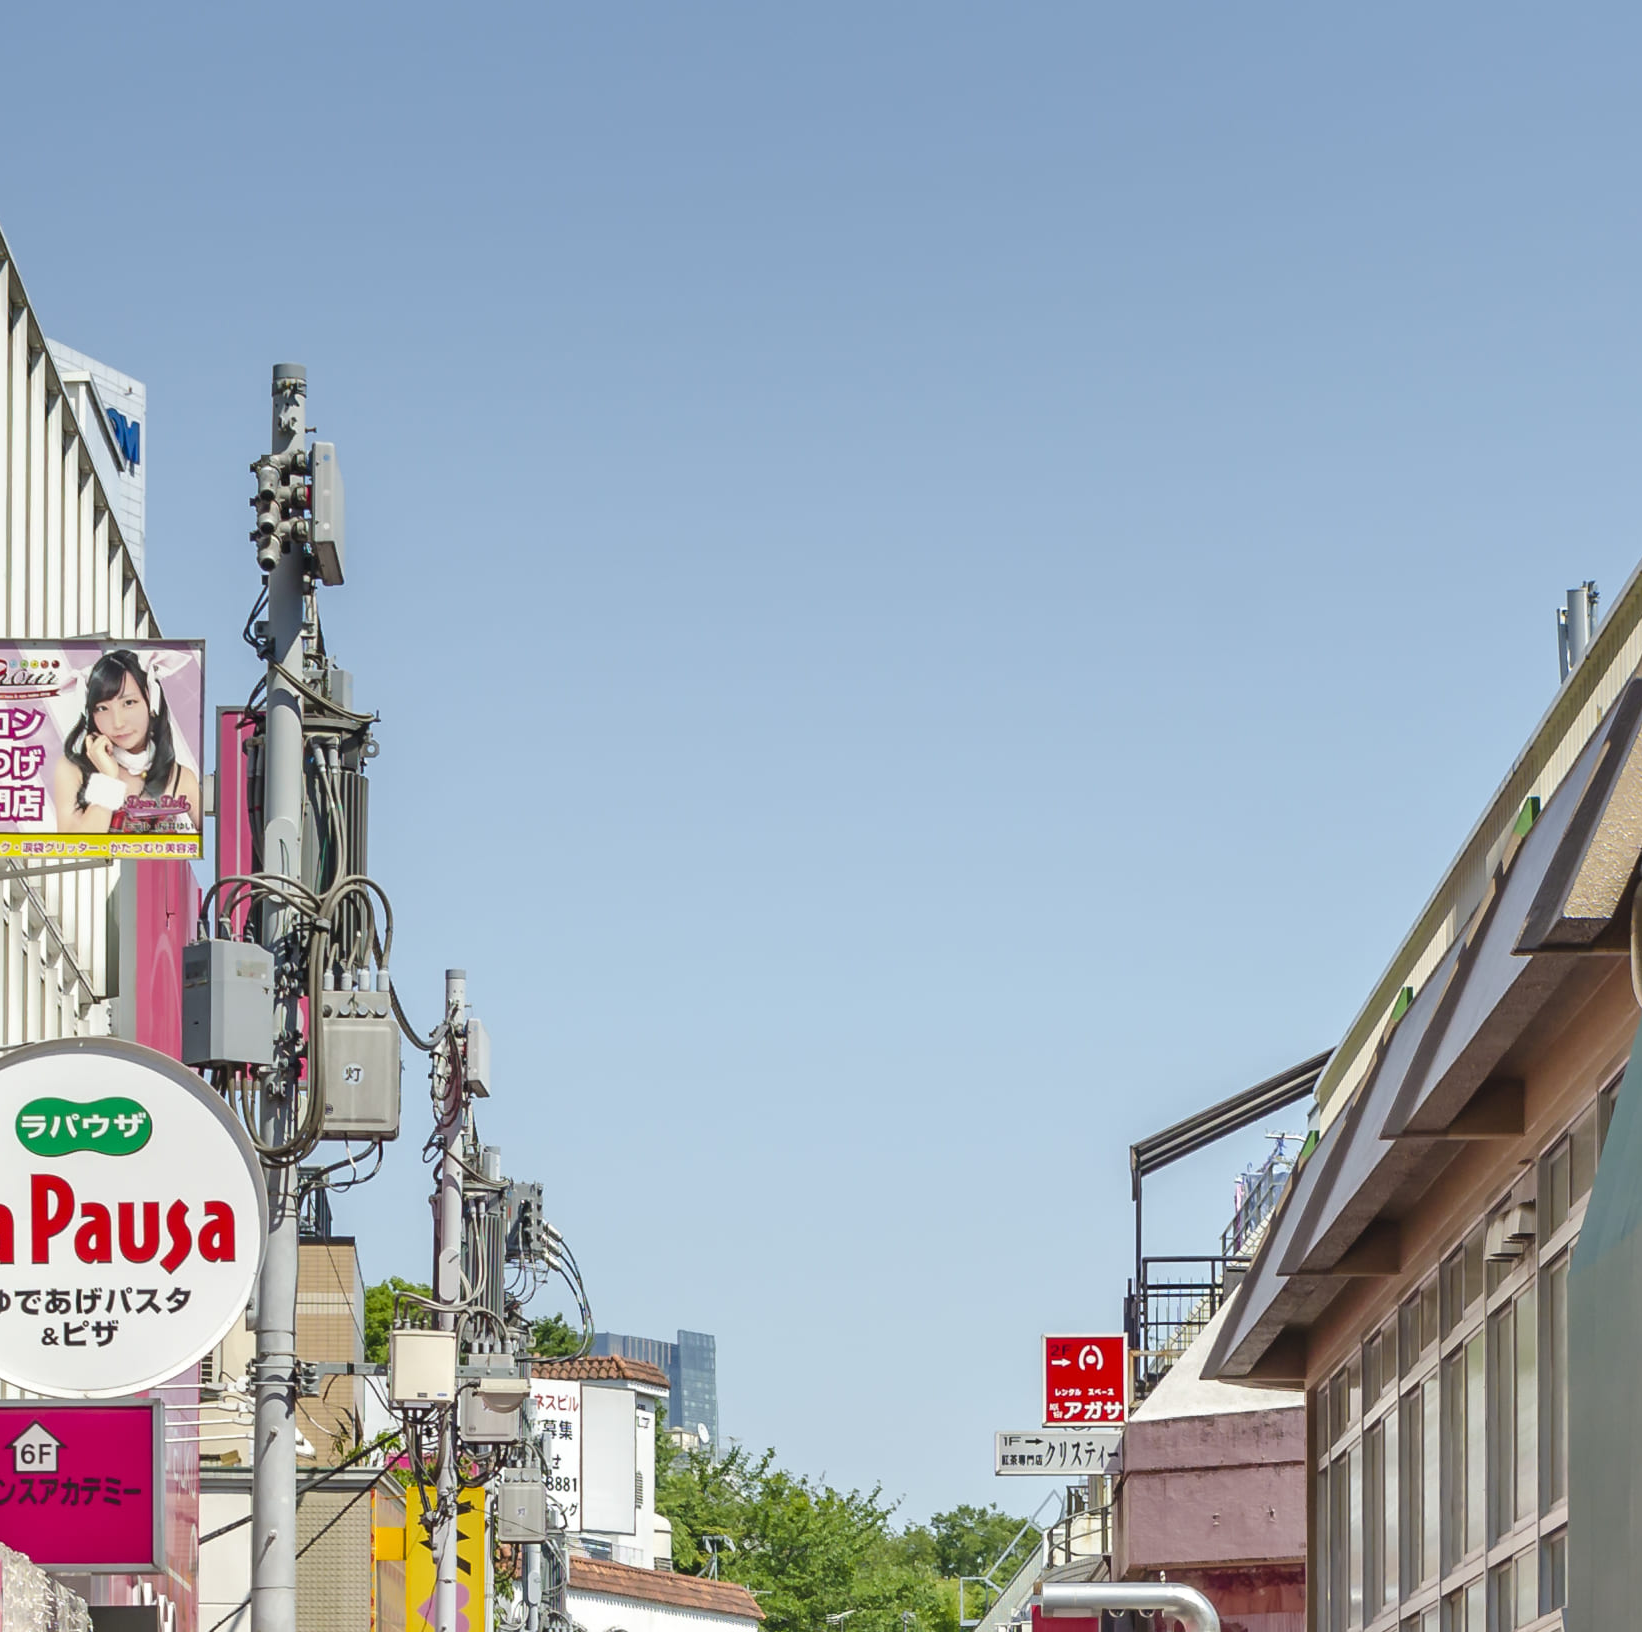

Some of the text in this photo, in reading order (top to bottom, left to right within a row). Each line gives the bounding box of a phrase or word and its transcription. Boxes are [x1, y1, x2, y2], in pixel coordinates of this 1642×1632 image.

[20, 1112, 147, 1139] ラパウザ
[41, 1320, 119, 1347] &ピザ
[1050, 1344, 1071, 1357] 2F
[1054, 1388, 1115, 1397] レンタル スペース
[1063, 1401, 1123, 1420] アガサ
[1003, 1436, 1022, 1447] 1F
[20, 1443, 53, 1465] 6F
[1044, 1441, 1119, 1468] クリスティー
